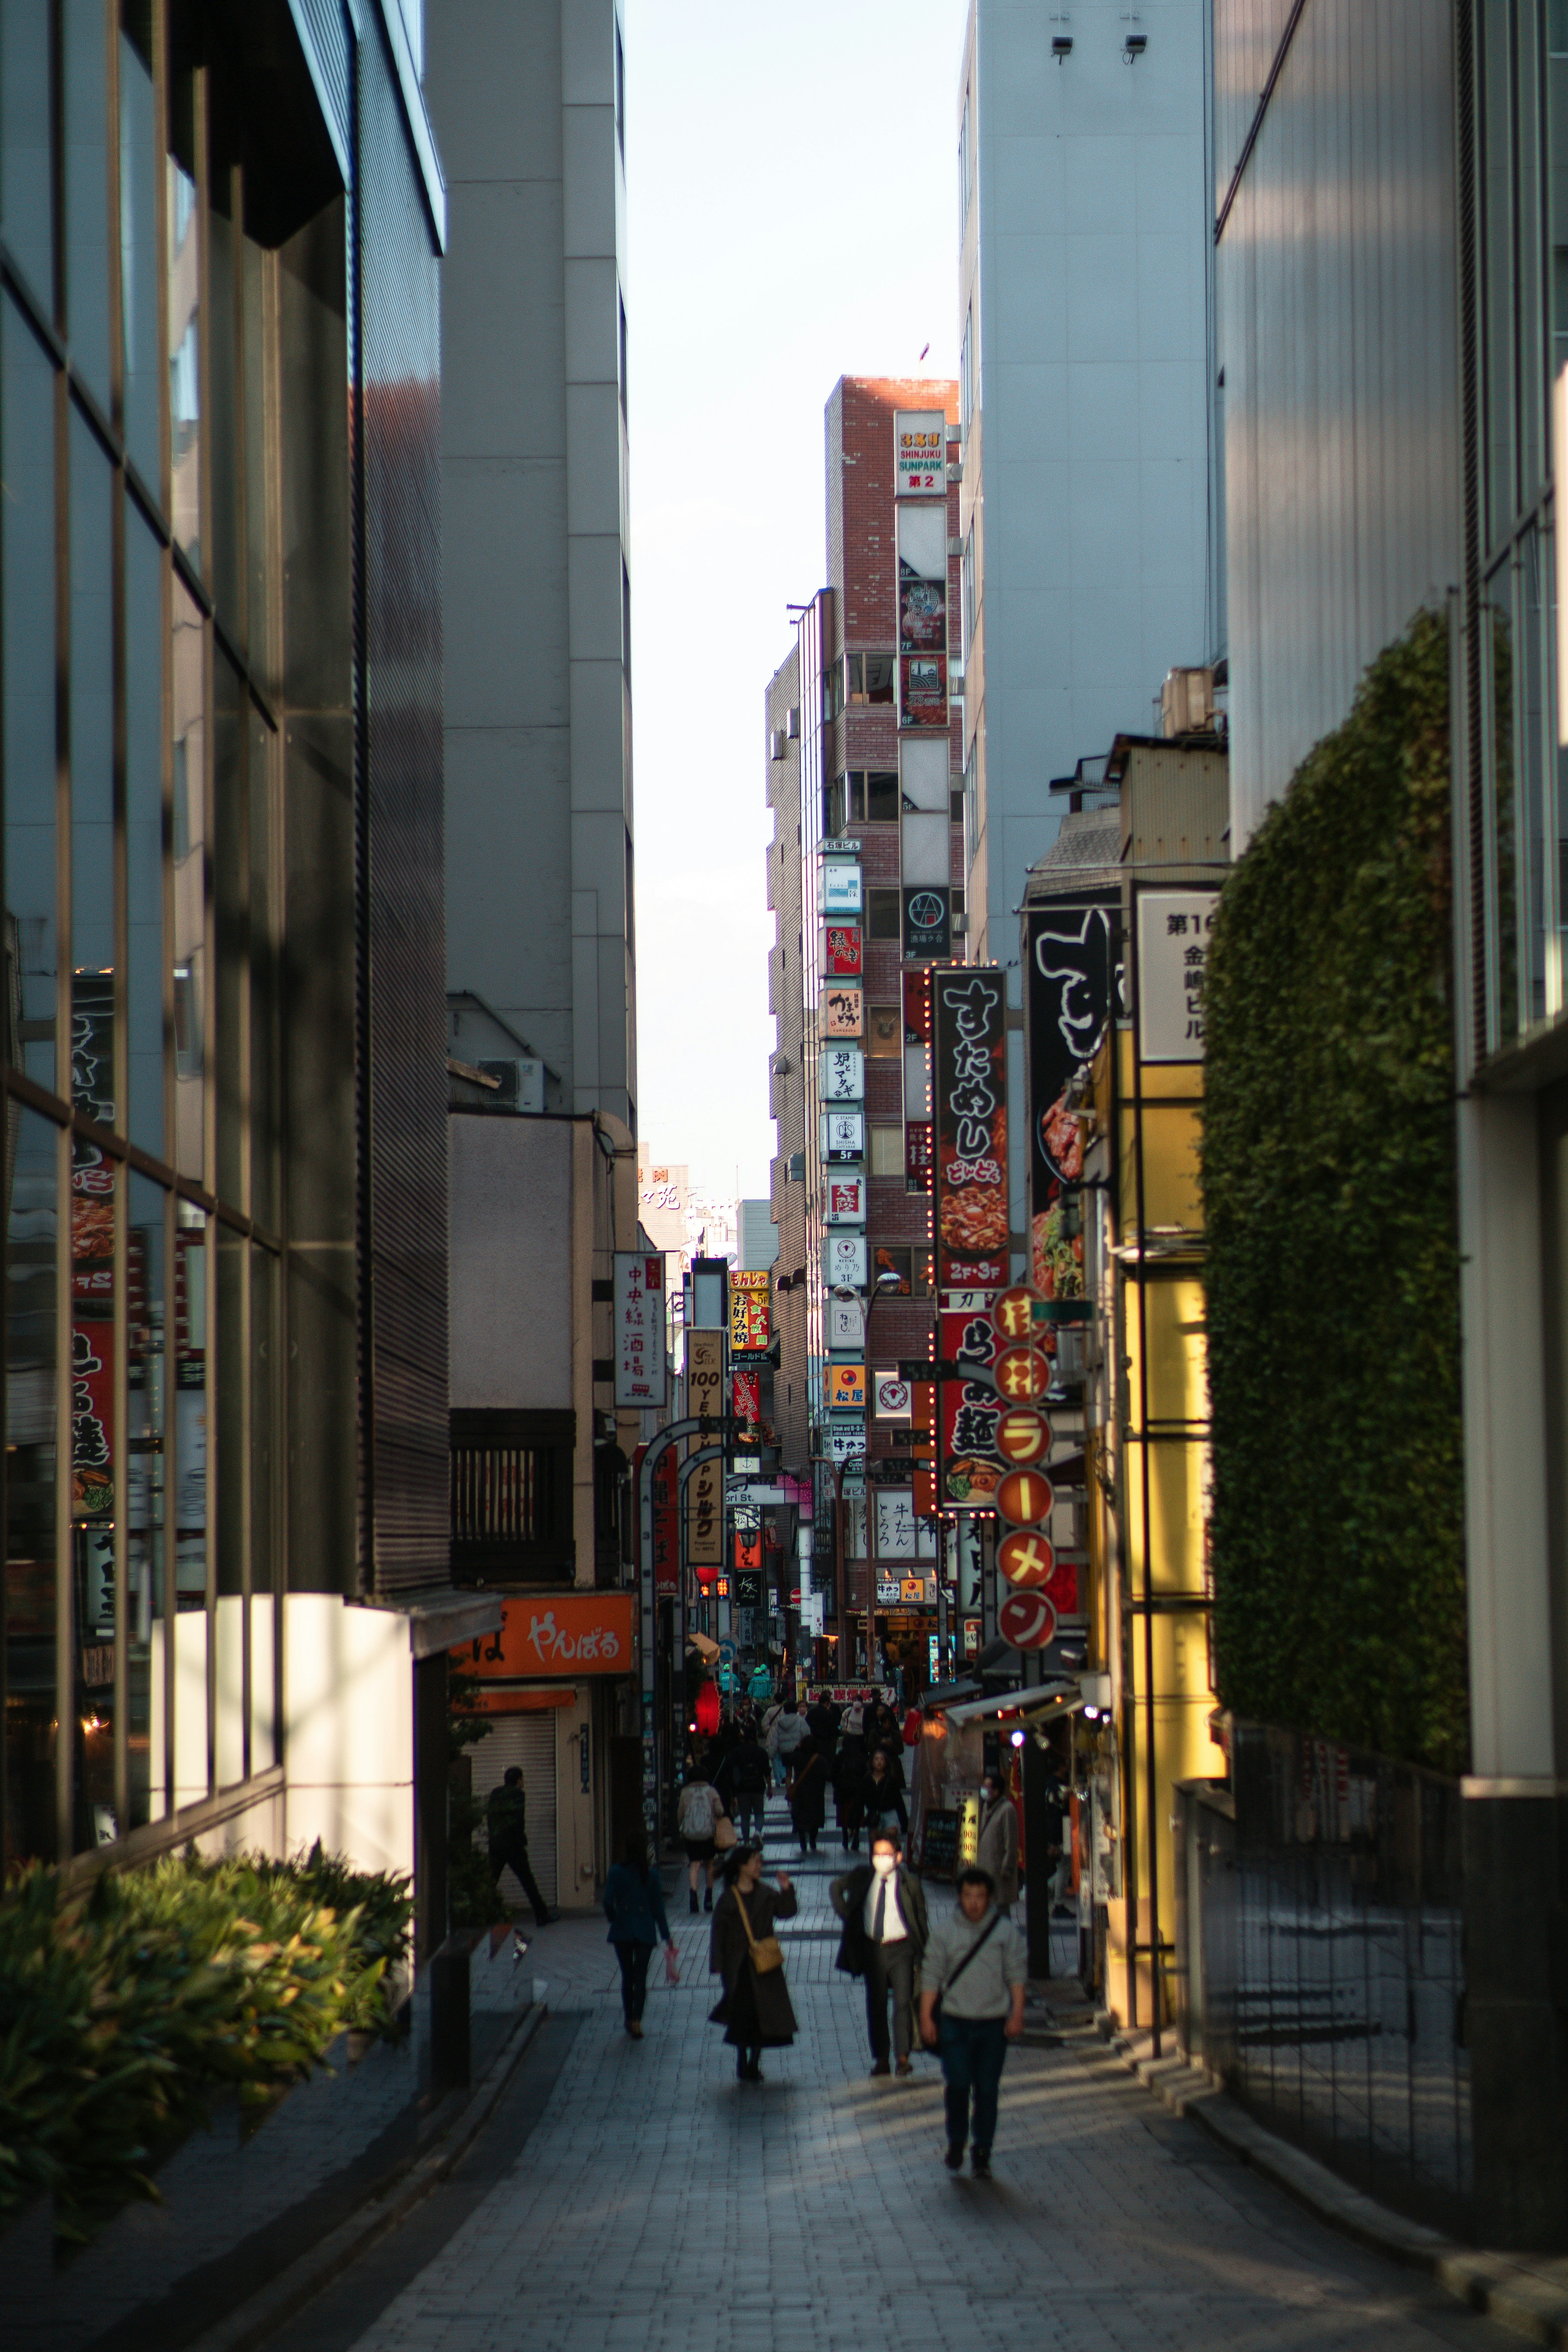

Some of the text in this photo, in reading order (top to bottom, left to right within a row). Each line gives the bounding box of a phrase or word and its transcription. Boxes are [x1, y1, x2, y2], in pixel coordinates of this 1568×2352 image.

[901, 450, 940, 459] SHINJUKU
[899, 461, 942, 472] SUNPARK
[827, 841, 858, 849] 石塚ビル
[833, 1052, 855, 1097] 炉とマタギ
[840, 1150, 852, 1159] 5F
[731, 1272, 767, 1287] もんじゃ
[758, 1293, 767, 1305] 5F
[733, 1294, 749, 1344] お好み焼
[691, 1372, 719, 1386] 100
[734, 1373, 758, 1413] OKONOMI
[835, 1390, 863, 1402] 松屋
[737, 1396, 755, 1424] ALL YOU
[834, 1438, 865, 1451] 牛かつ
[879, 1503, 889, 1546] とろろ
[893, 1503, 909, 1546] 牛たん
[878, 1584, 899, 1593] 牛かつ
[527, 1610, 619, 1663] やんばる
